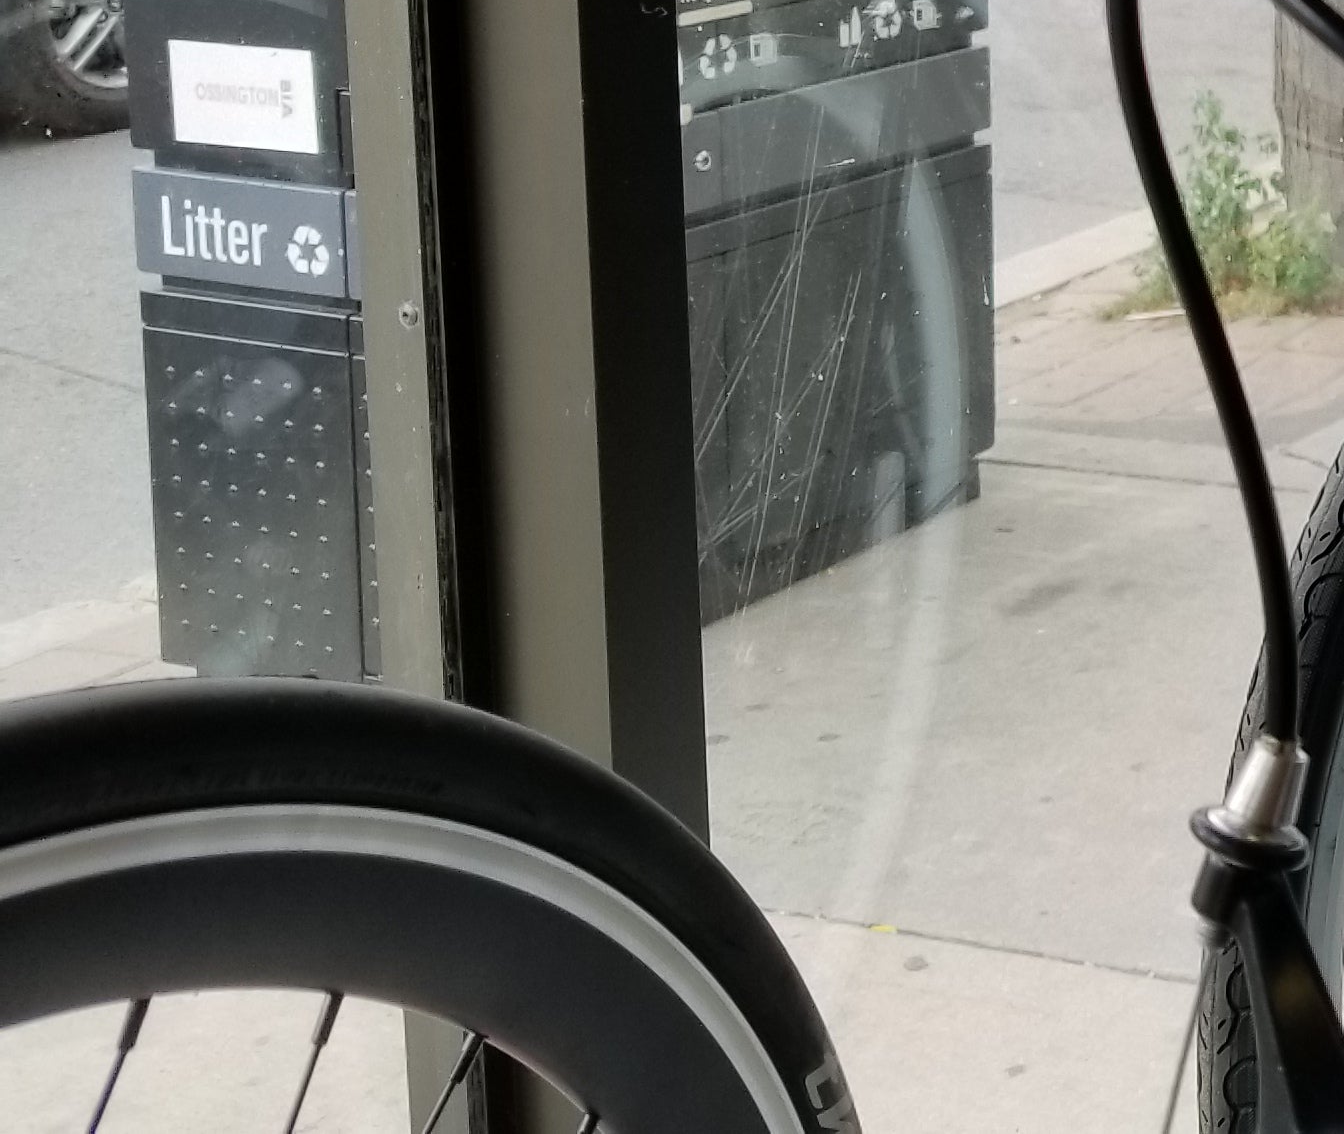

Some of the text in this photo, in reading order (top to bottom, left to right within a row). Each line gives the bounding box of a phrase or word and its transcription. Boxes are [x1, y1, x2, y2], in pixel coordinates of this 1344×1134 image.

[195, 81, 281, 108] OSSINGTON
[280, 79, 293, 118] BIA
[161, 195, 268, 266] Litter
